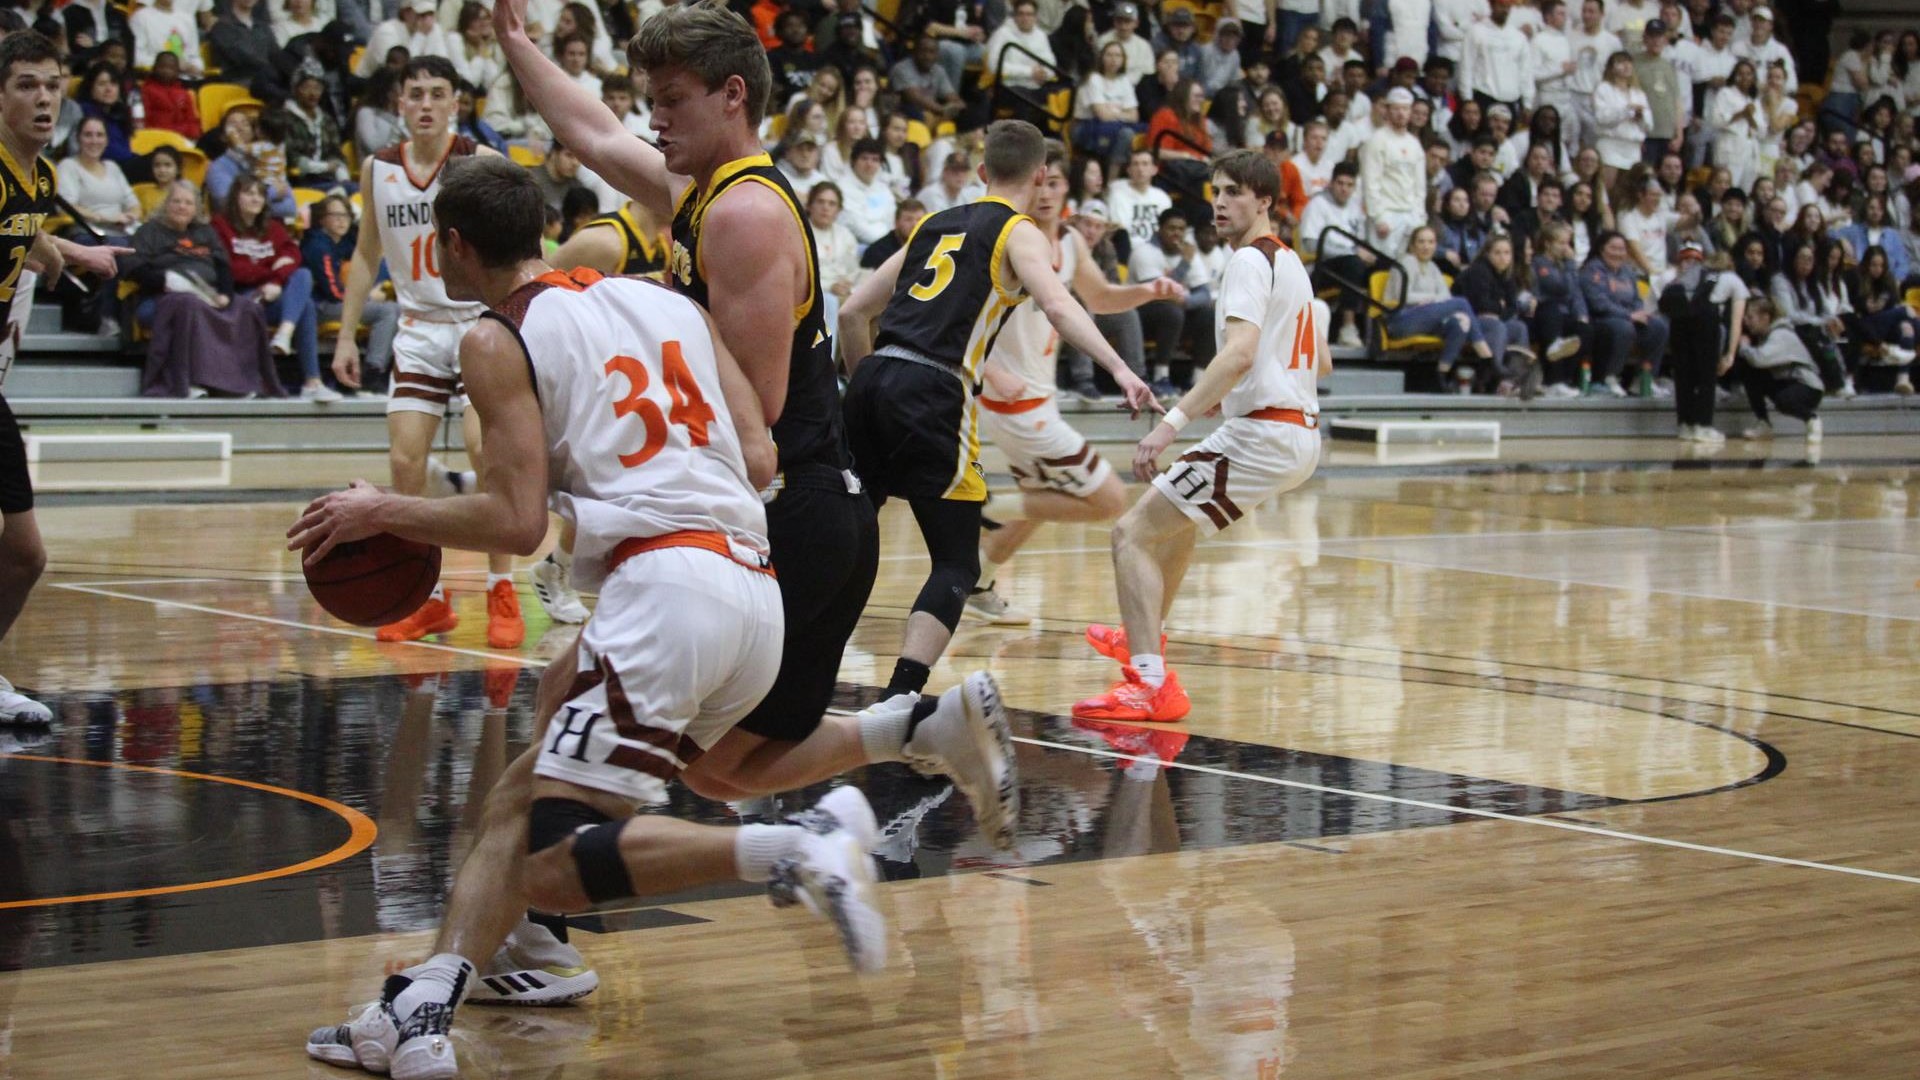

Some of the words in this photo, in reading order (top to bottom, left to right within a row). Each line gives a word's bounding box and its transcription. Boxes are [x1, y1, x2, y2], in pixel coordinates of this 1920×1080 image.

[387, 203, 434, 228] HEND
[908, 231, 967, 302] 5
[1288, 302, 1316, 370] 14
[604, 340, 717, 468] 34
[1170, 464, 1209, 500] H
[548, 705, 606, 763] H
